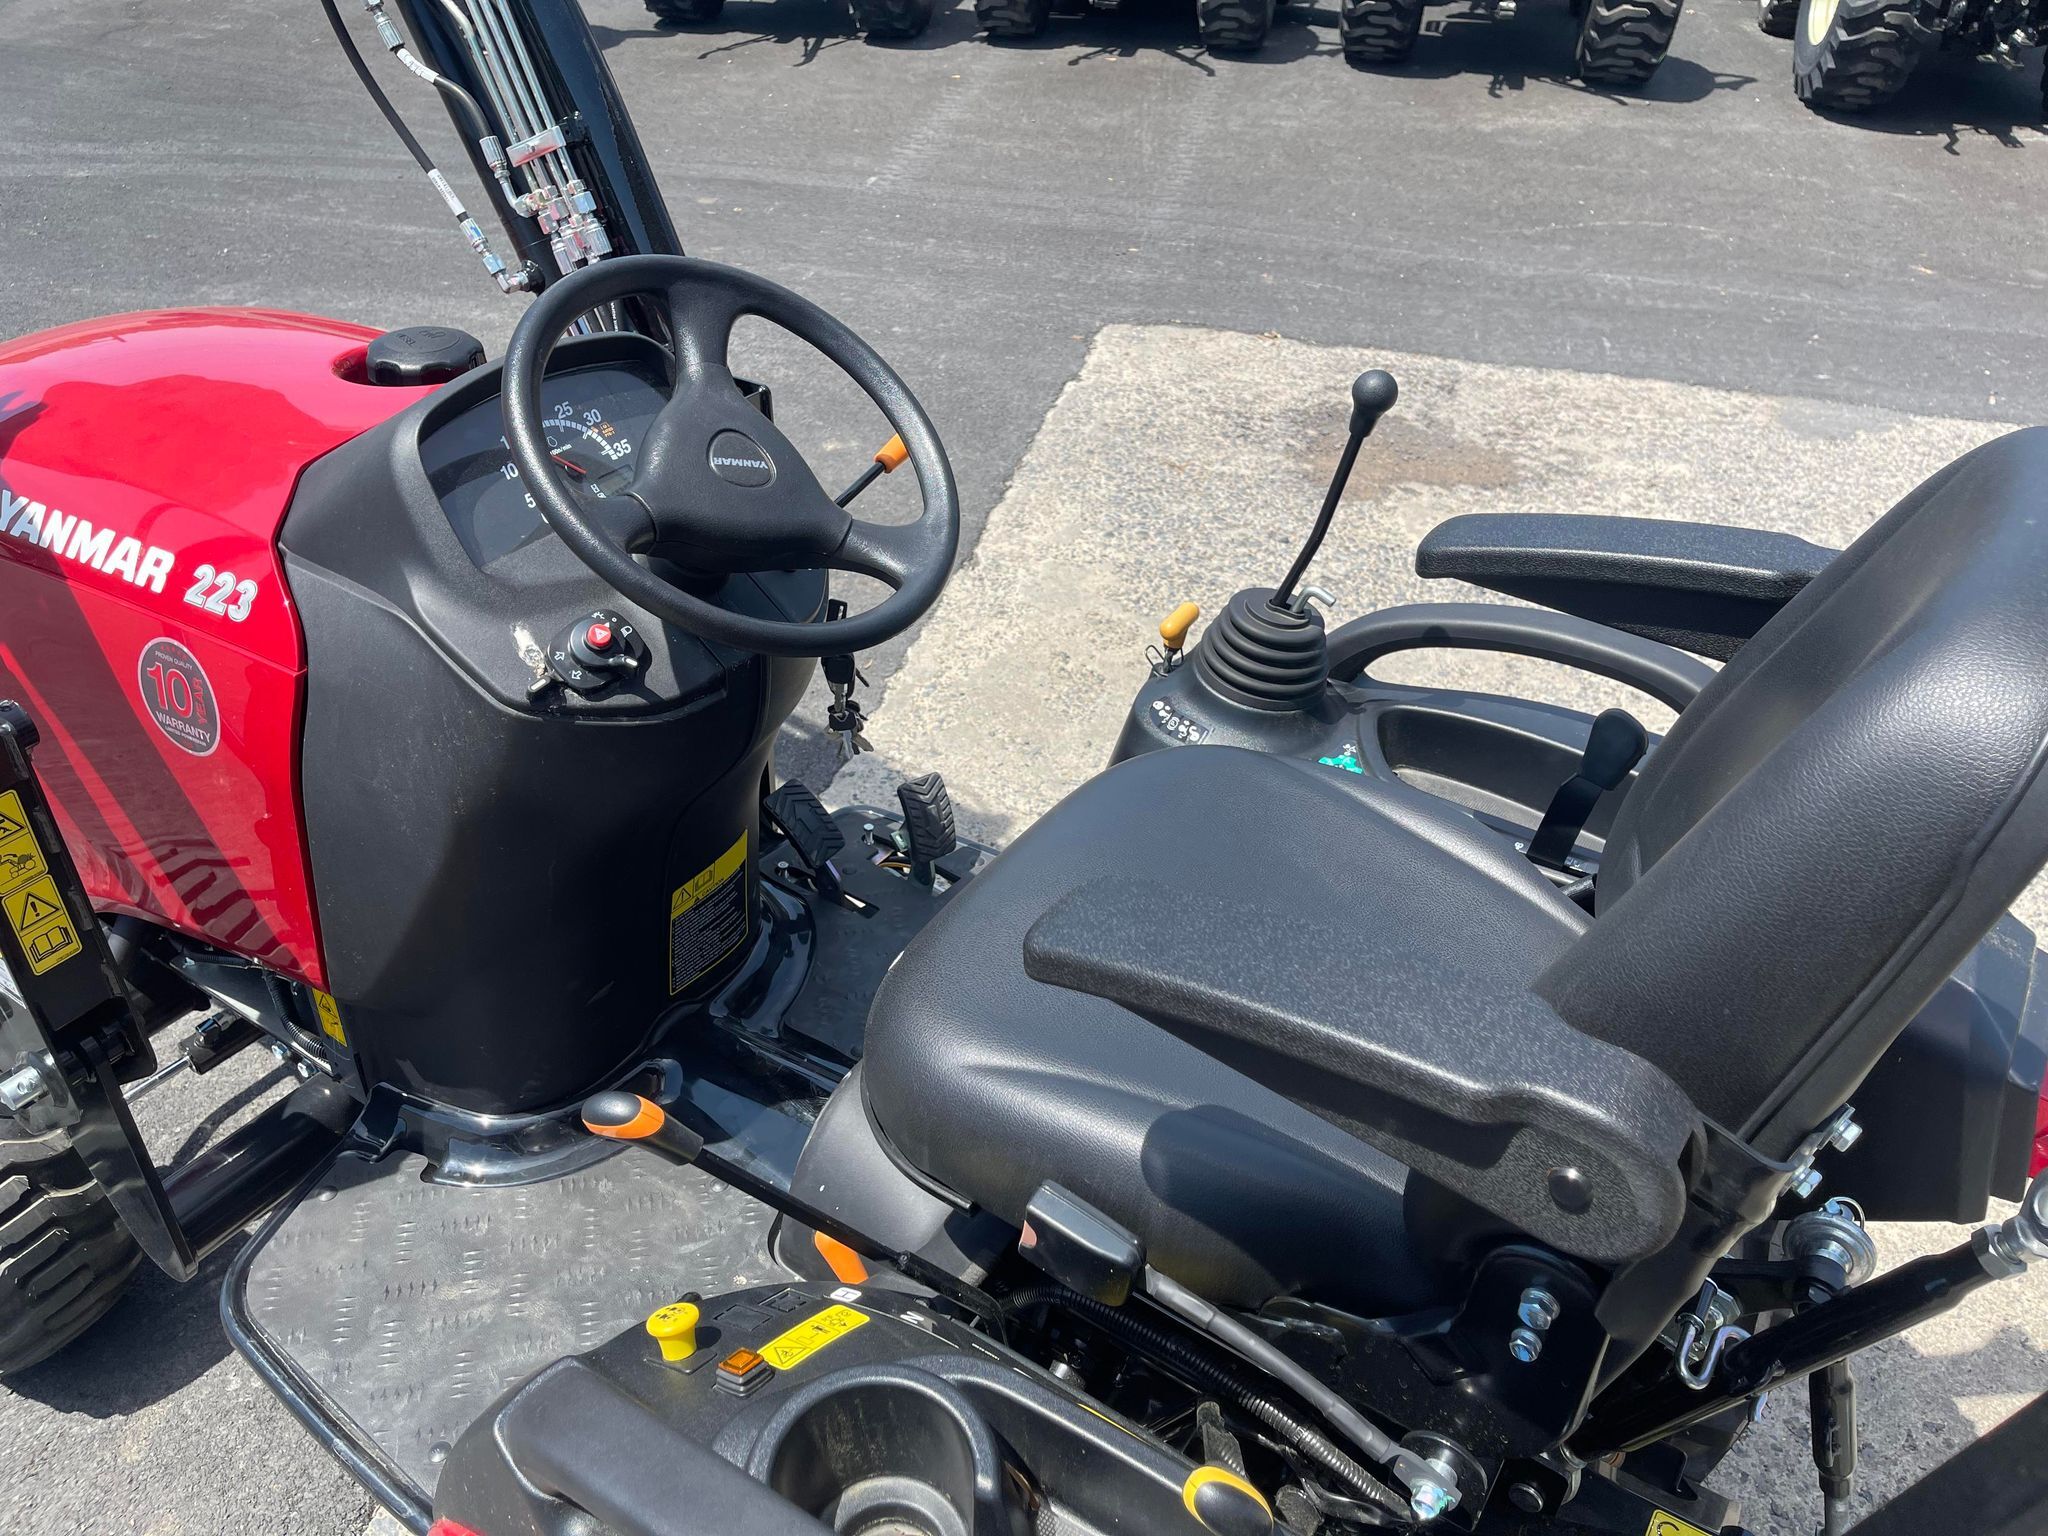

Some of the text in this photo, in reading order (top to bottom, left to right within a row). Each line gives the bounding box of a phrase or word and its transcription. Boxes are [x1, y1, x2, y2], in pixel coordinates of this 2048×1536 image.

[555, 401, 574, 420] 25
[583, 408, 602, 426] 30
[612, 438, 632, 457] 35
[500, 462, 519, 480] 10
[712, 456, 769, 470] YANMAR
[524, 493, 537, 508] 5
[0, 489, 175, 593] YANMAR
[183, 564, 258, 623] 223
[146, 661, 194, 719] 10
[155, 710, 211, 743] WARRANTY
